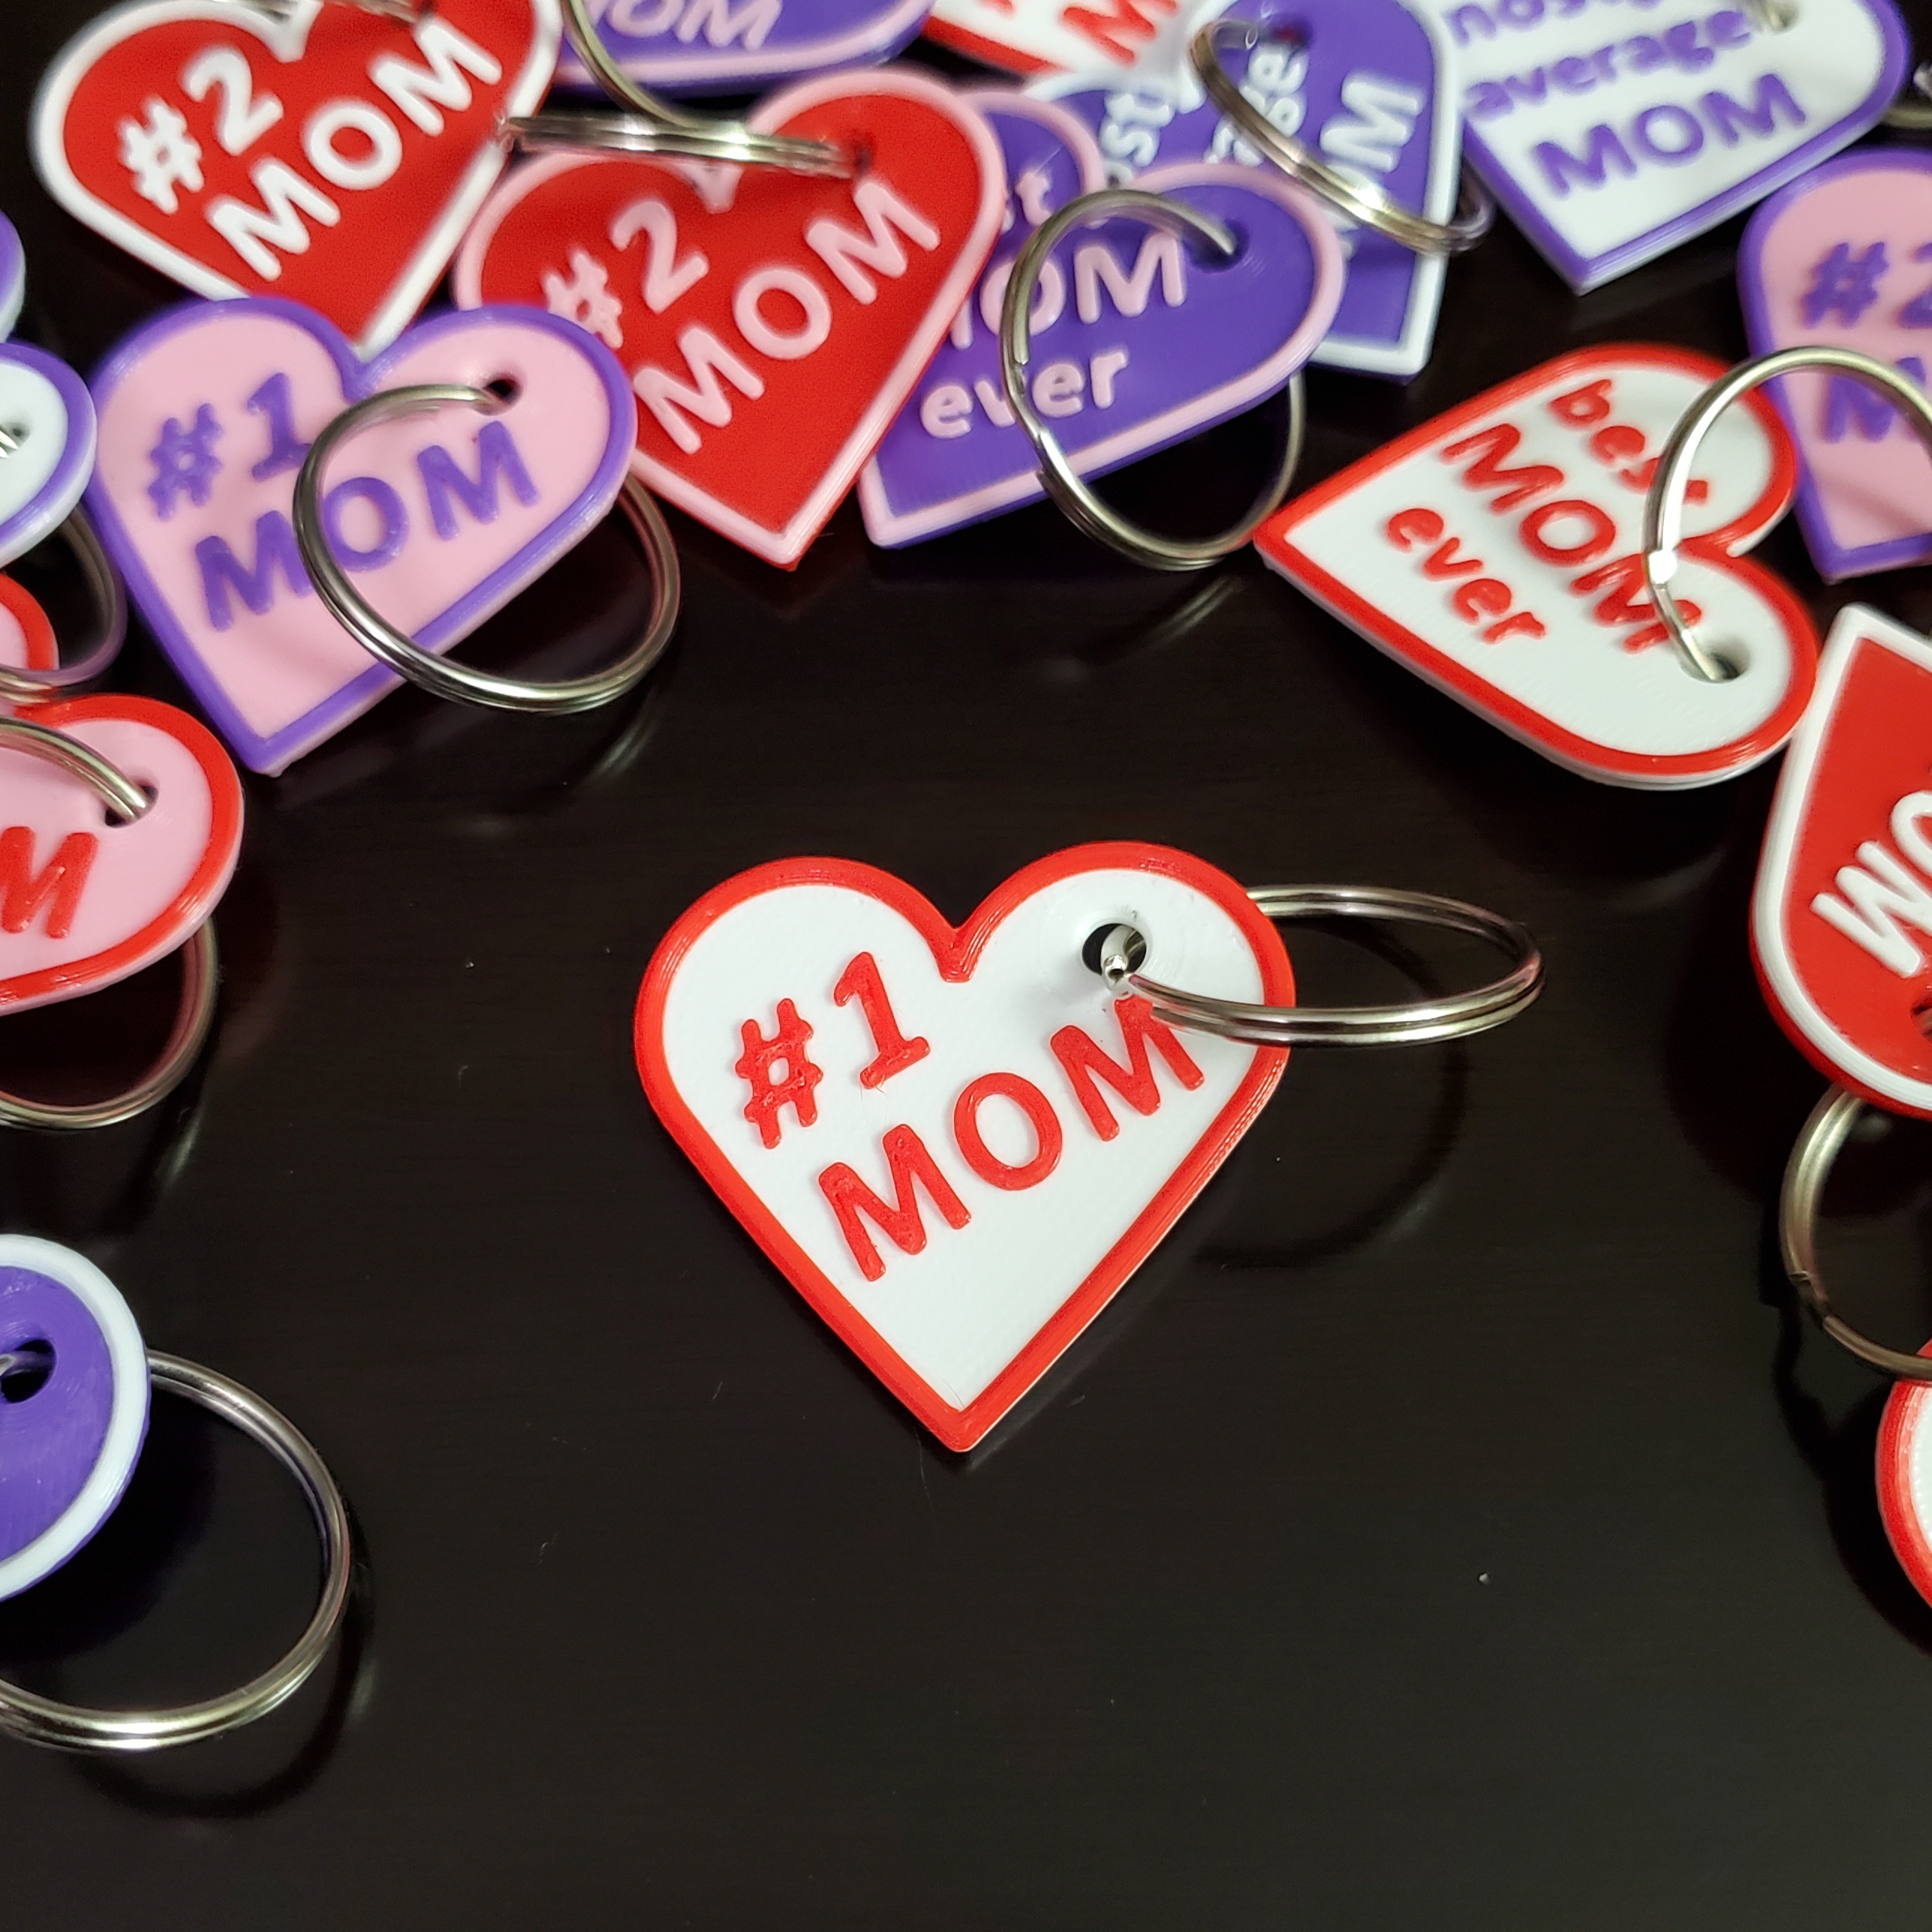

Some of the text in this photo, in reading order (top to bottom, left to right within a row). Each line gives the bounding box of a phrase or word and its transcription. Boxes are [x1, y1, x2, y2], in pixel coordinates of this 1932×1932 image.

[118, 45, 284, 215] #2
[206, 17, 502, 281] MOM
[1464, 11, 1752, 122] average
[1534, 74, 1806, 199] MOM
[540, 198, 709, 349] #2
[633, 180, 940, 453] MOM
[148, 372, 312, 521] #1
[194, 419, 539, 632] MOM
[1438, 423, 1702, 655] MOM
[1386, 507, 1547, 644] ever
[735, 950, 931, 1150] #1
[818, 992, 1205, 1282] MOM
